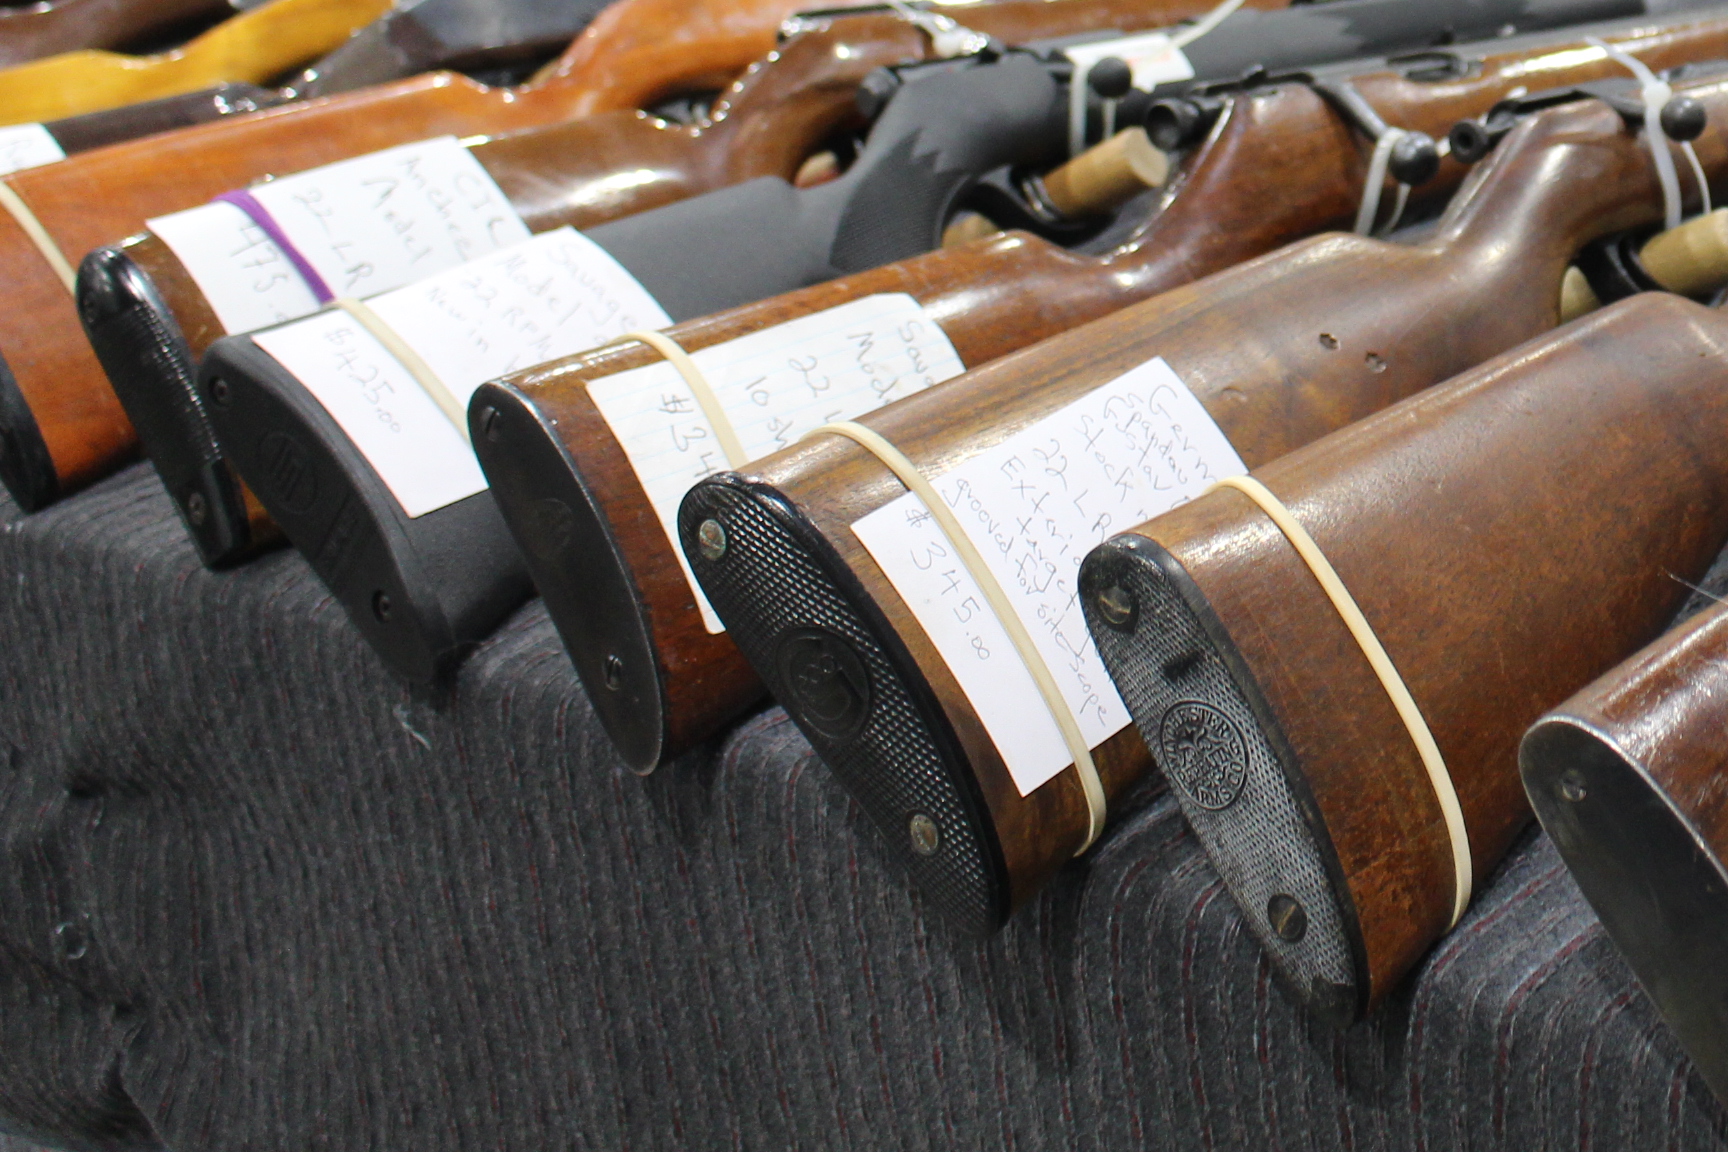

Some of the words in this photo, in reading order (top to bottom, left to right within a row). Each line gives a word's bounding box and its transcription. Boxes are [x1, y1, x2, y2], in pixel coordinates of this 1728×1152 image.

[293, 186, 334, 235] 22
[465, 270, 498, 309] 22
[323, 327, 401, 434] $425.00
[788, 355, 831, 398] 22
[1032, 438, 1068, 490] 22
[942, 478, 1014, 563] grooved
